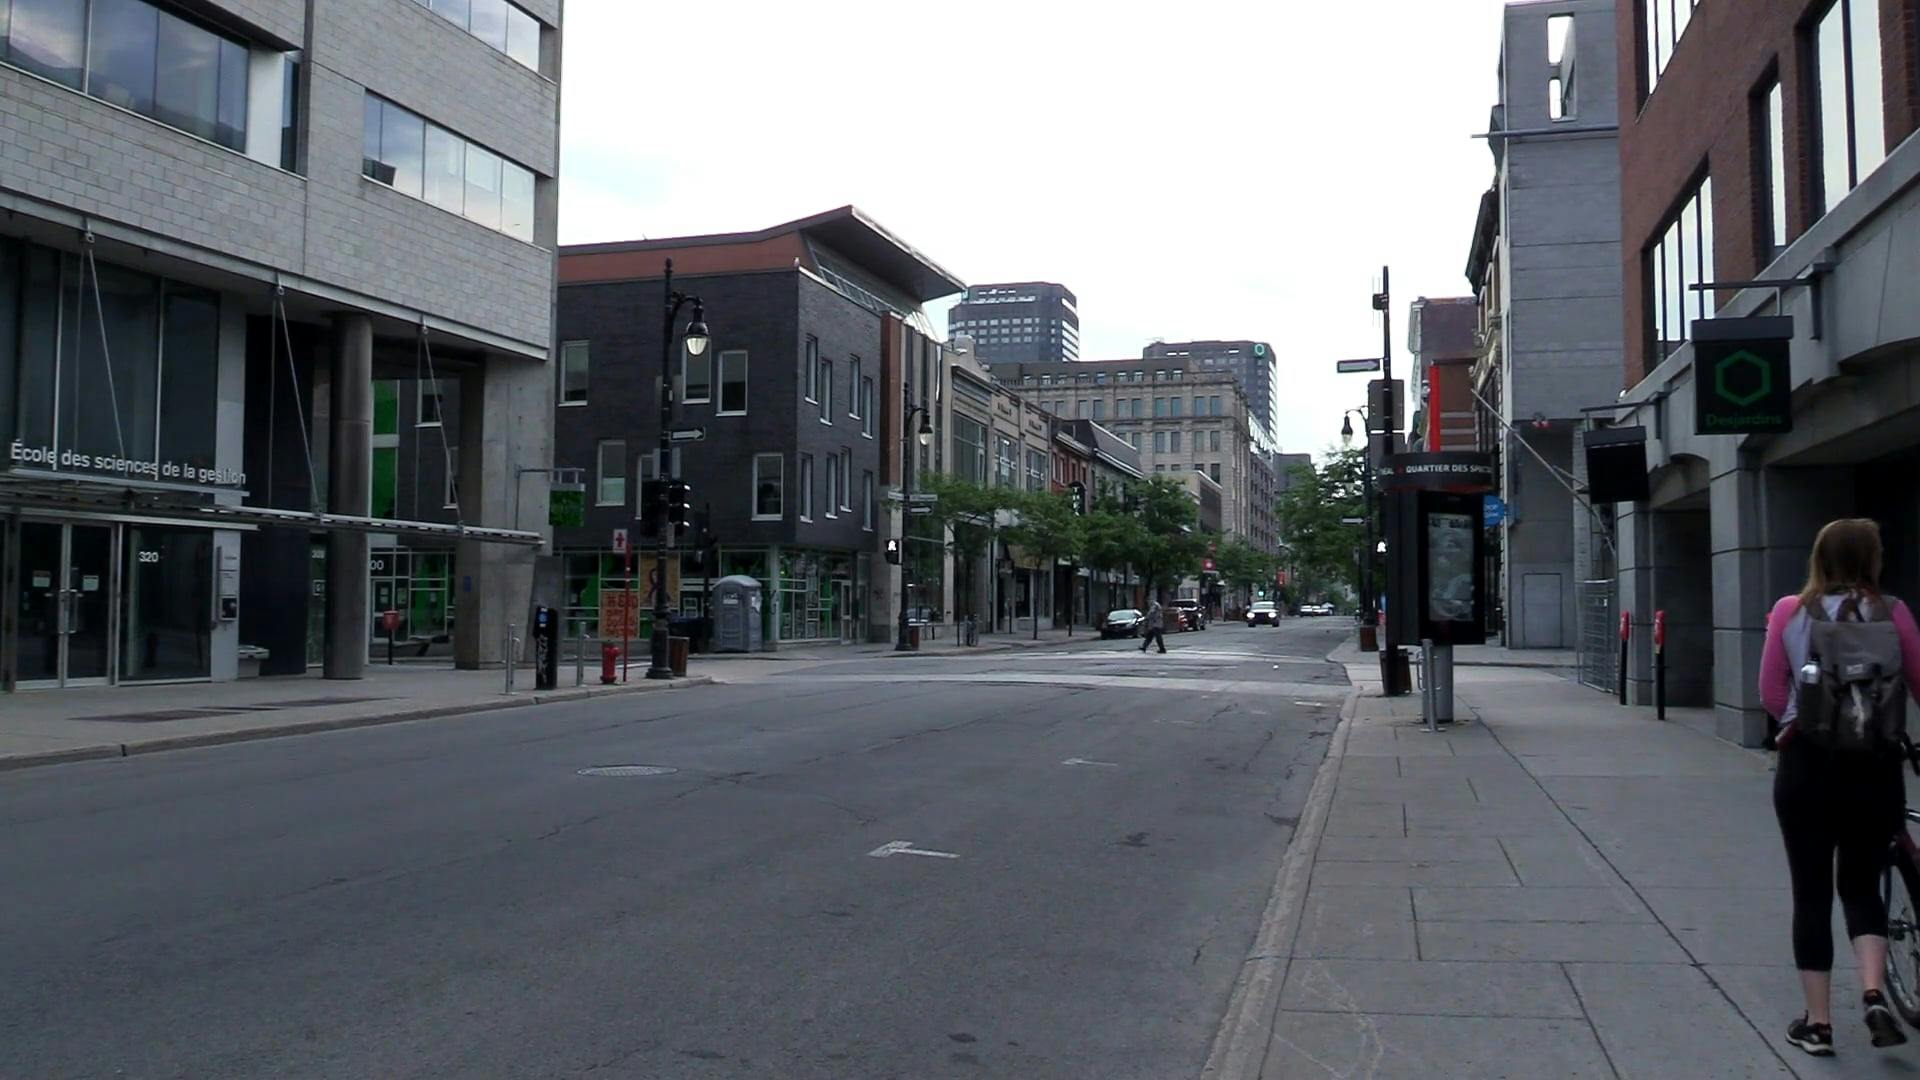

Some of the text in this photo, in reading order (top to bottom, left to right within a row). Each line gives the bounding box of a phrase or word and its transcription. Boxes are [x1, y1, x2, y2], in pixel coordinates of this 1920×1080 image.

[1705, 412, 1783, 429] Desjardins
[10, 438, 246, 485] École des sciences de la gestion
[1406, 464, 1450, 474] QUARTIER
[1451, 464, 1468, 473] DES
[139, 551, 159, 562] 320
